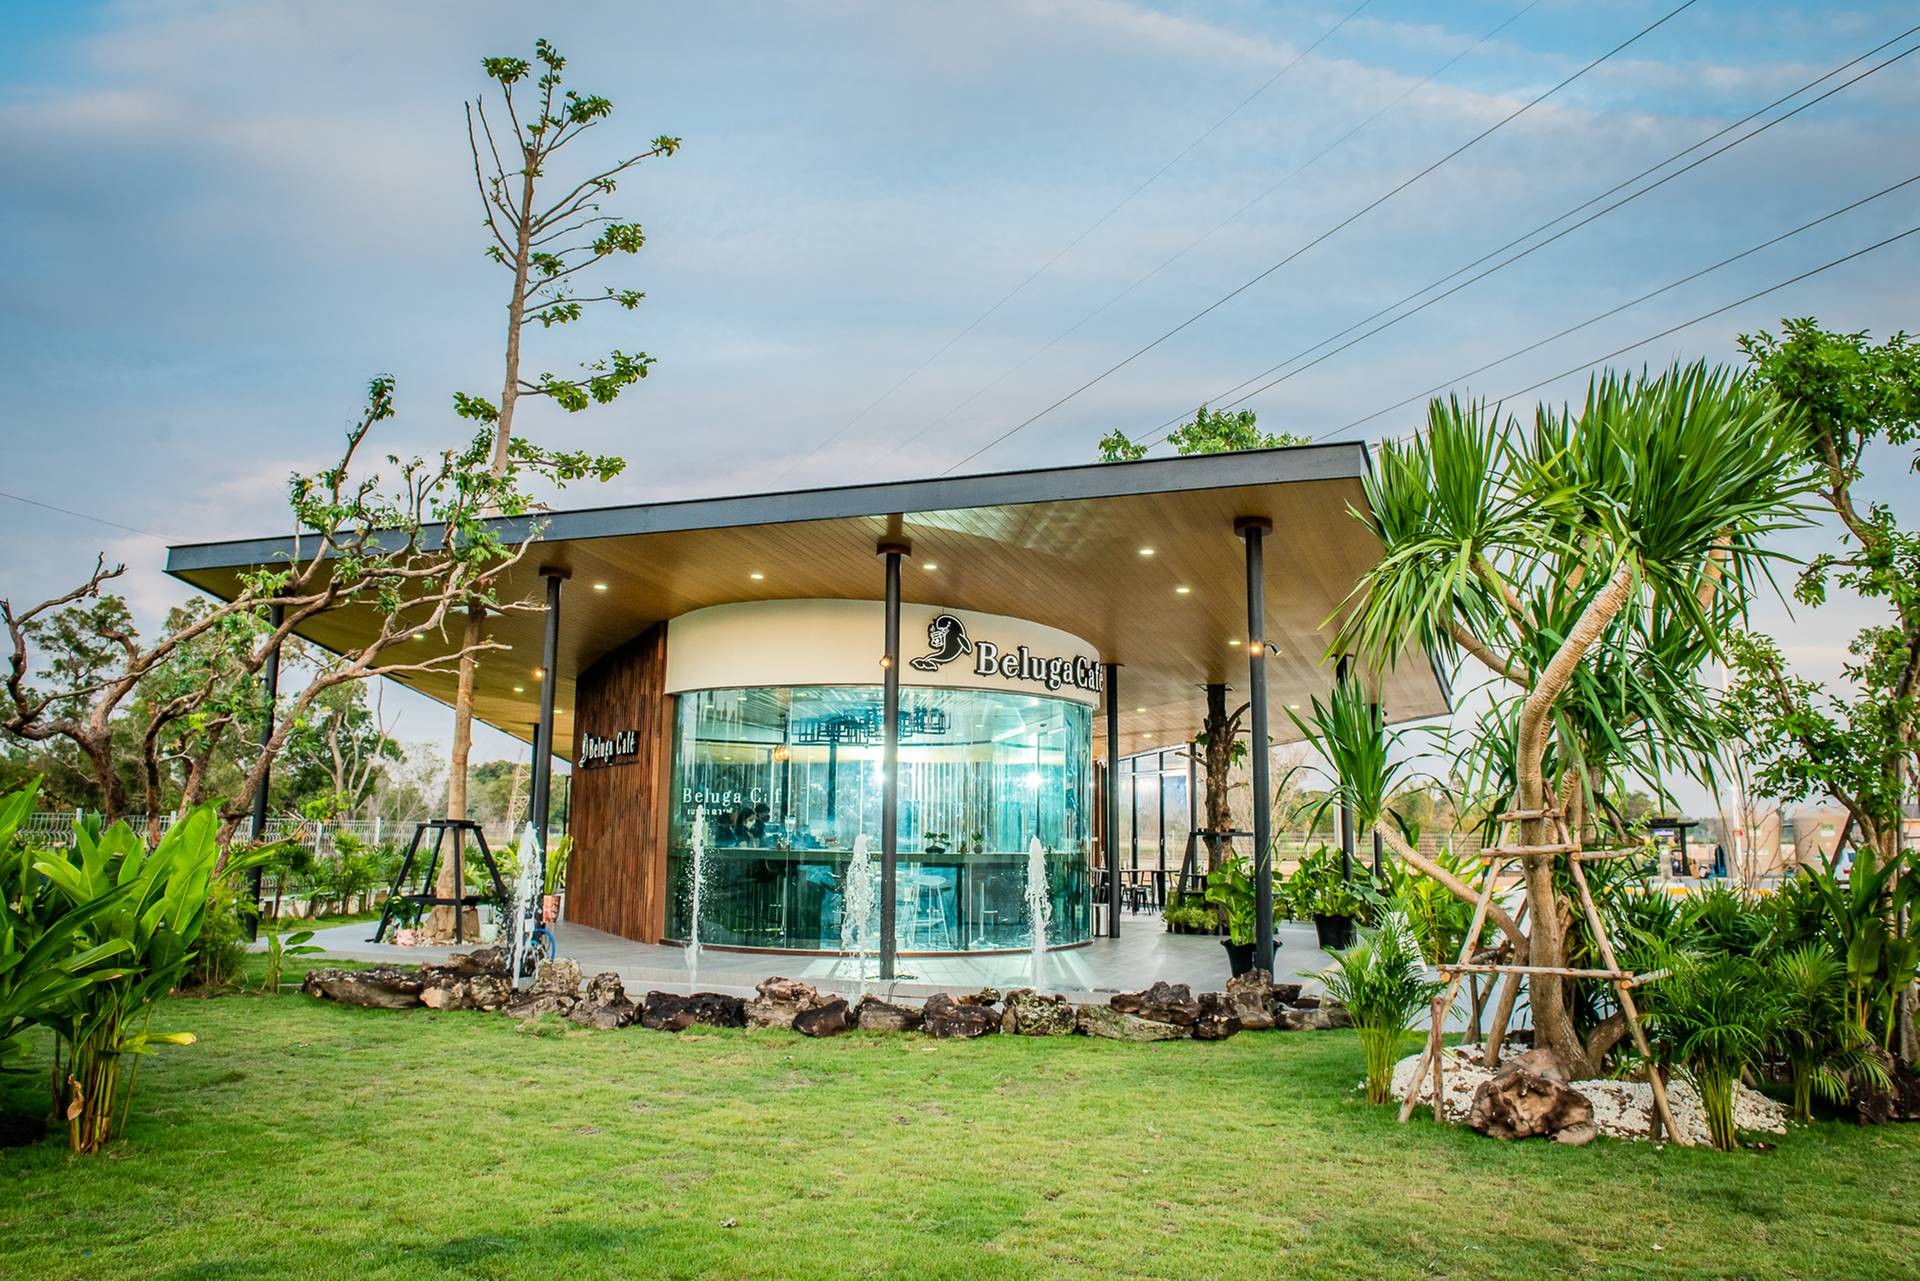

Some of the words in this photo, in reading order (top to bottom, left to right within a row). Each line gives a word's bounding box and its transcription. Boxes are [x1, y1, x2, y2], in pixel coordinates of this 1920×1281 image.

[975, 641, 1074, 690] Beluga
[1074, 656, 1103, 692] Café
[588, 736, 614, 763] Beluga
[616, 730, 635, 755] Café
[682, 787, 742, 807] Beluga
